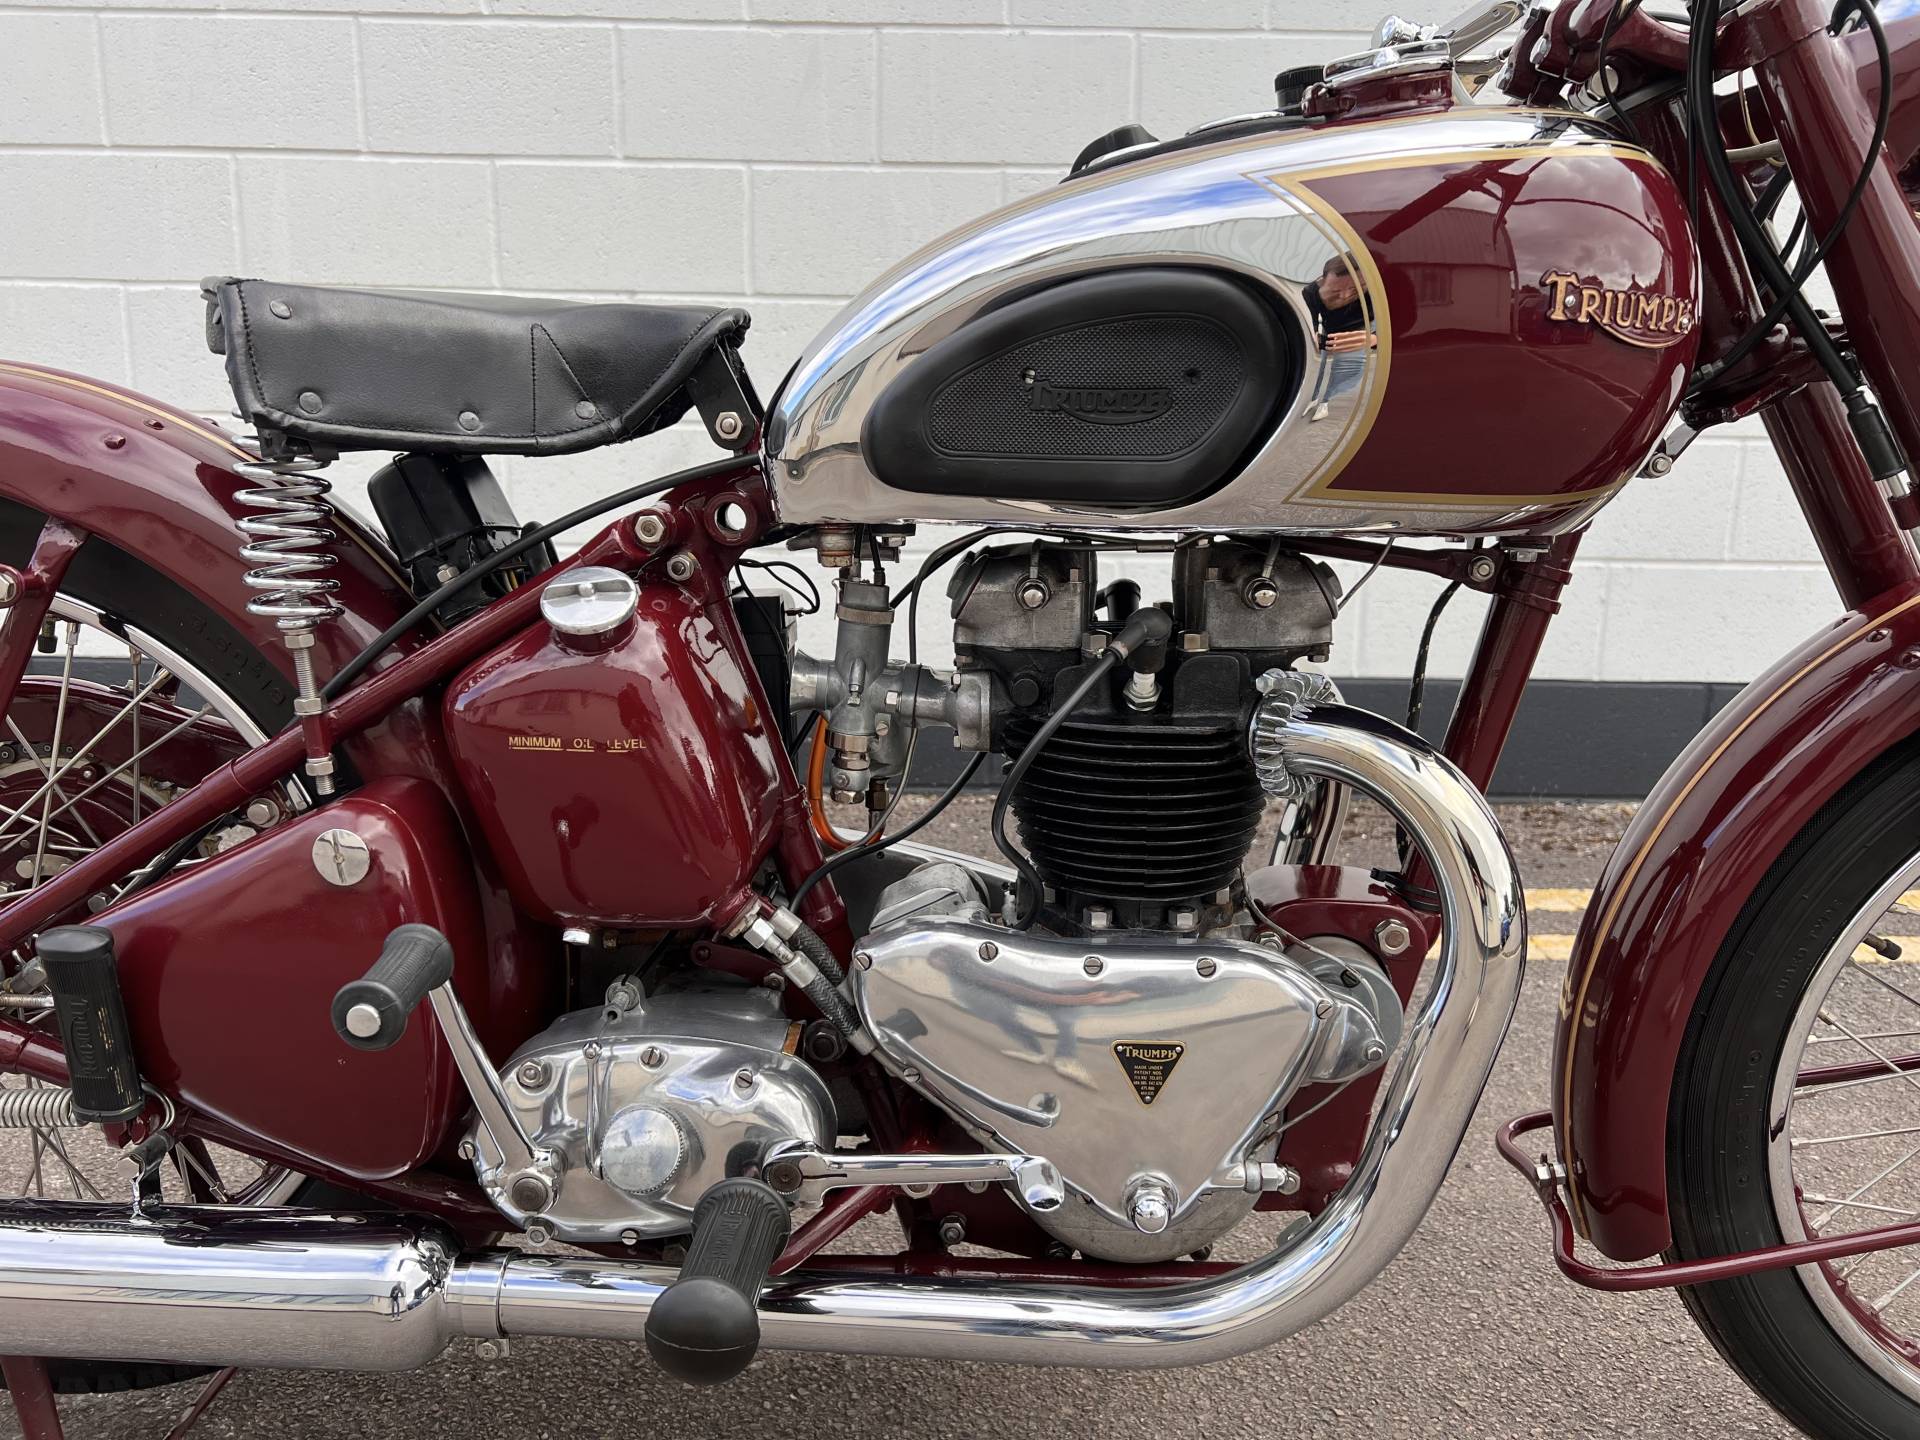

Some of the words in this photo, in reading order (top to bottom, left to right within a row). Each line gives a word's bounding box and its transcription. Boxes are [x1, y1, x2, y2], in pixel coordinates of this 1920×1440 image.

[1541, 270, 1693, 347] TRIUMPH
[1023, 381, 1171, 423] TRIUMPH
[508, 736, 561, 748] MINIMUM
[606, 738, 647, 749] LEVEL
[1122, 1045, 1178, 1062] TRIUMPH
